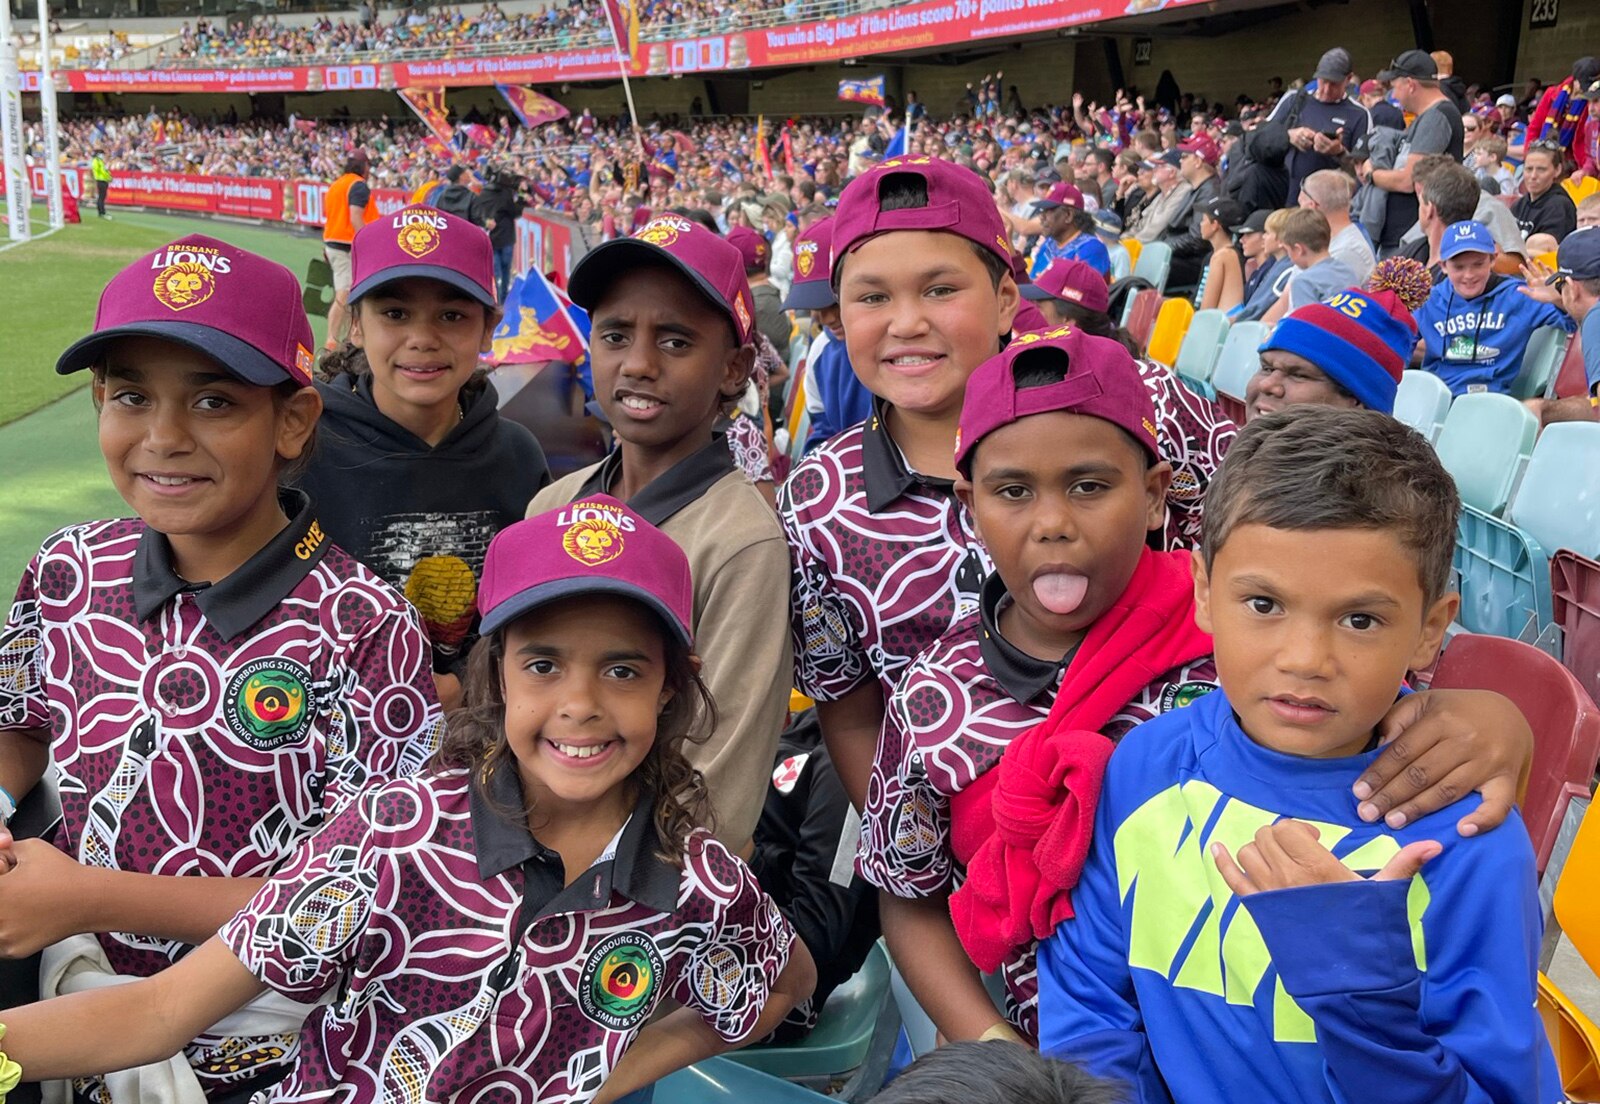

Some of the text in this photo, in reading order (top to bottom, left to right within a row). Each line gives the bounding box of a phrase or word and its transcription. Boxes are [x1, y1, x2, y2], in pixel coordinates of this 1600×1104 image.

[1532, 0, 1558, 22] 233
[767, 32, 786, 48] You
[787, 27, 806, 46] win
[807, 30, 814, 43] a
[816, 22, 834, 46] Big
[870, 15, 887, 34] the
[889, 10, 918, 31] Lions
[920, 6, 954, 25] score
[955, 0, 978, 20] 70+
[393, 214, 448, 230] LIONS
[167, 244, 220, 256] BRISBANE
[151, 251, 231, 274] LIONS
[1434, 312, 1505, 337] RUSSELL
[572, 502, 624, 514] BRISBANE
[556, 508, 636, 532] LIONS
[229, 661, 316, 712] CHERBOURG STATE SCHOOL
[227, 707, 253, 743] STRONG,
[253, 735, 284, 748] SMART
[292, 722, 308, 740] SAFE
[587, 935, 633, 973] CHERBOURG
[634, 936, 655, 957] STATE
[595, 1010, 621, 1026] SMART
[622, 1017, 630, 1026] &
